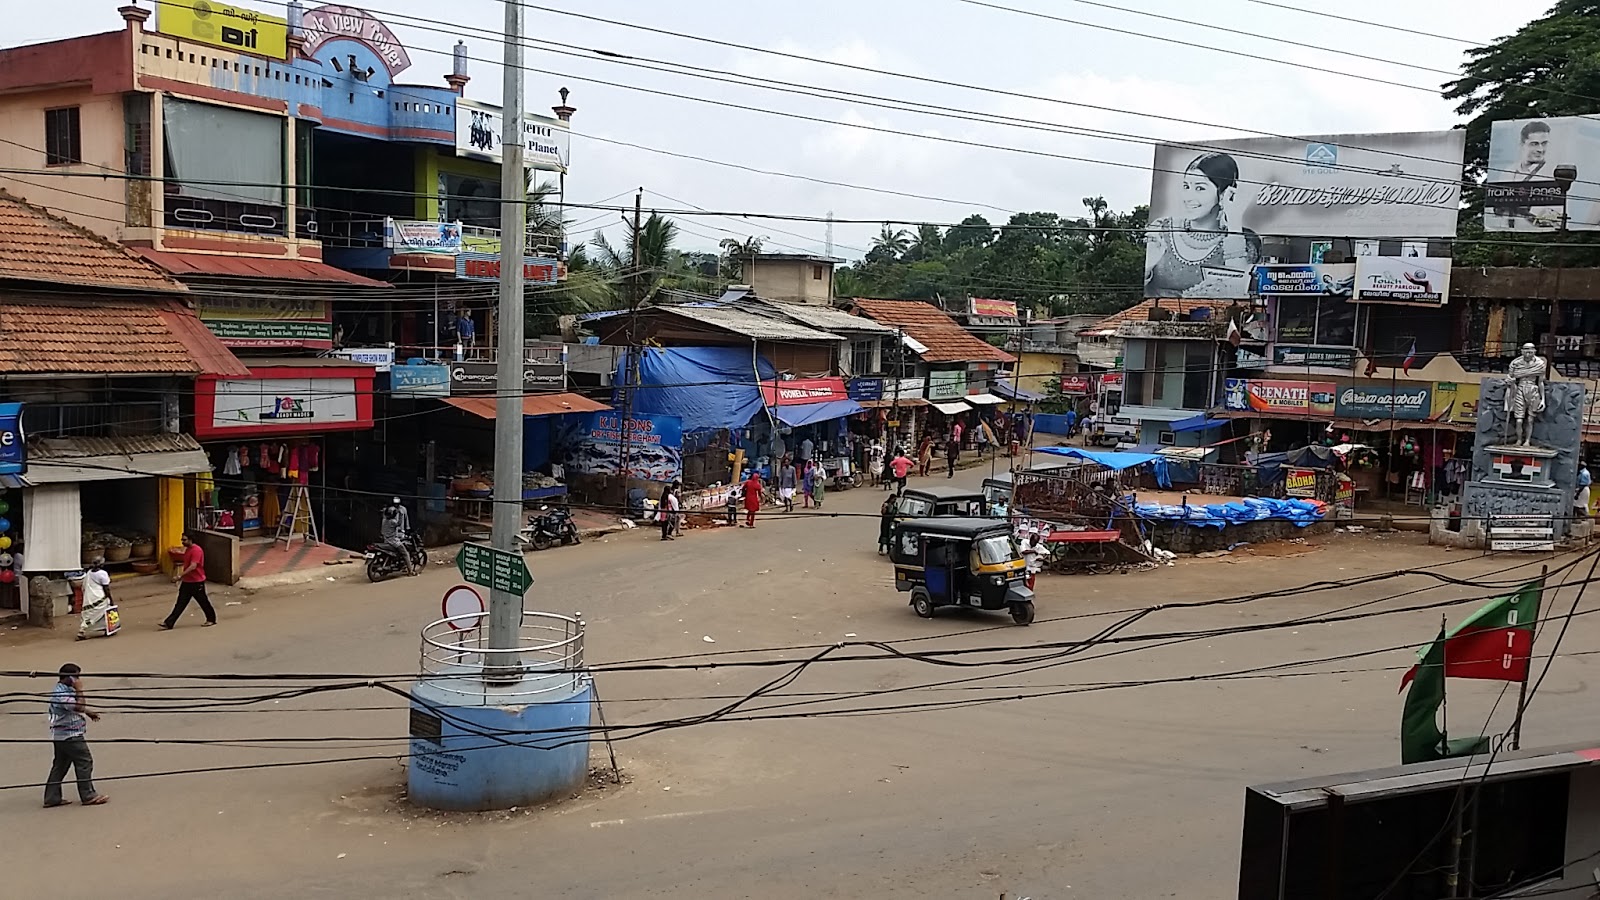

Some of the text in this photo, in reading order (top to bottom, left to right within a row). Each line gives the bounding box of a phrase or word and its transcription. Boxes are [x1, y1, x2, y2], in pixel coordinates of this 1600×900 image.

[370, 23, 402, 68] Tower
[528, 140, 558, 155] Planet
[1487, 187, 1515, 198] frank
[1529, 186, 1562, 198] jones
[620, 418, 654, 433] SONS
